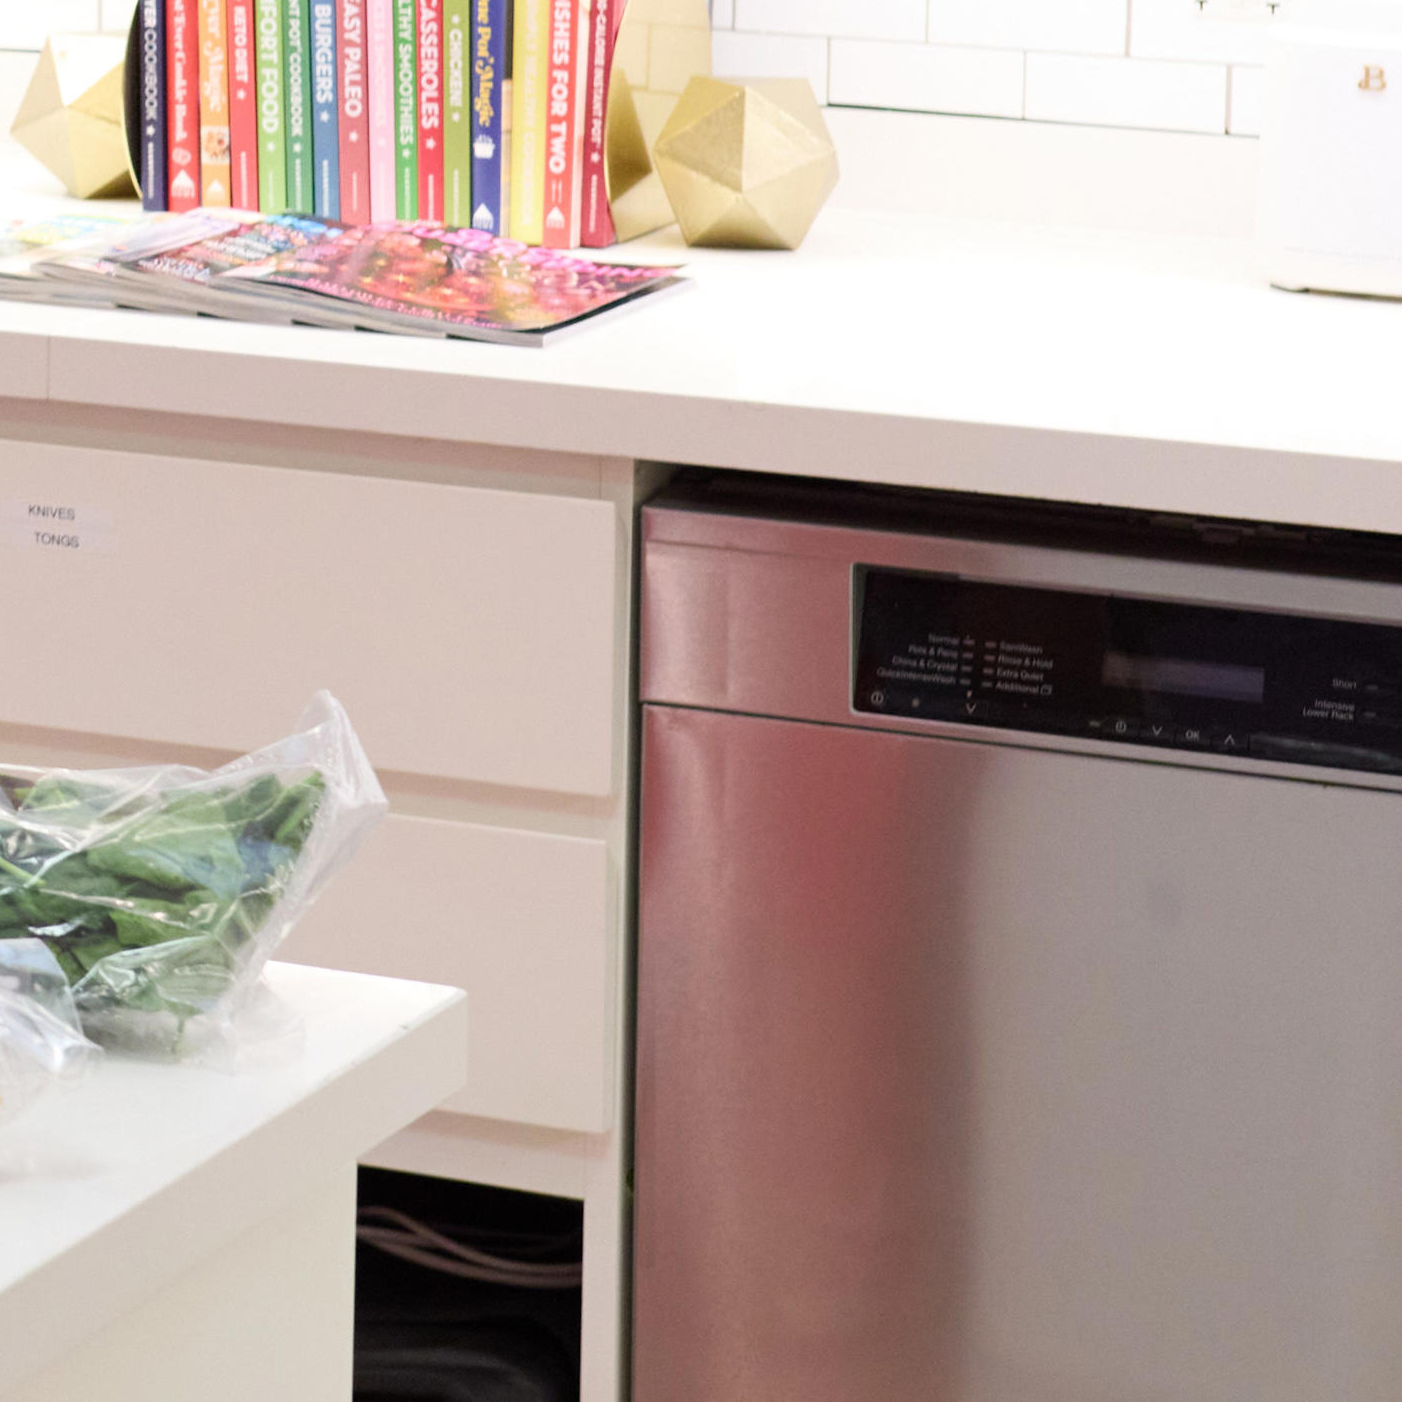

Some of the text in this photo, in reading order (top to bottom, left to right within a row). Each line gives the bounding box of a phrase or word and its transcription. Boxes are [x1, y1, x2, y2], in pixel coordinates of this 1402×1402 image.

[144, 29, 158, 121] COOKBOOK
[234, 6, 248, 84] KETO DIET
[314, 4, 333, 104] BURGERS
[261, 68, 279, 134] FOOD
[289, 52, 303, 137] COOKBOOK
[344, 46, 363, 119] PALEO
[399, 43, 414, 146] SMOOTHIES
[474, 60, 495, 128] Magic
[551, 69, 568, 118] FOR
[549, 121, 567, 175] TWO
[27, 504, 76, 521] KNIVES
[34, 531, 80, 549] TONGS
[1302, 708, 1330, 720] Lower
[1331, 677, 1357, 690] Short
[1185, 729, 1200, 741] OK
